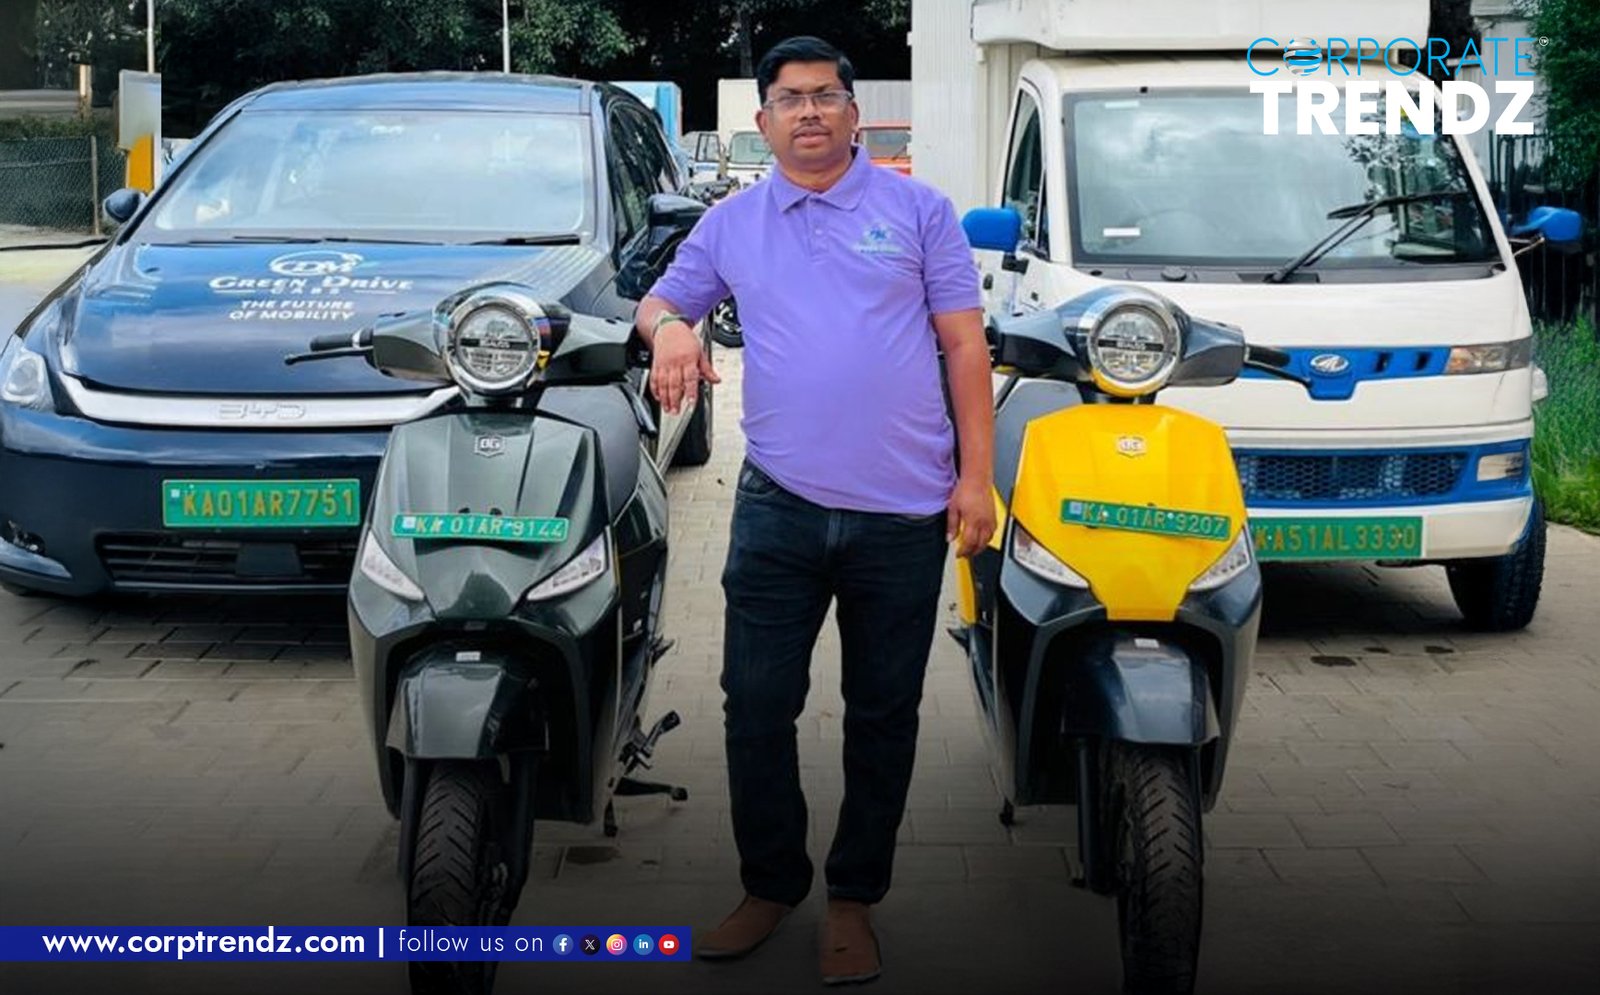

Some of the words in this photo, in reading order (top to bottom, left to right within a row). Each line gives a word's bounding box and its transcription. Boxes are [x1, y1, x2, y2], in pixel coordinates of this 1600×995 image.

[241, 300, 275, 309] THE
[279, 300, 354, 309] FUTURE
[229, 310, 254, 320] OF
[259, 310, 356, 321] MOBILITY
[183, 489, 355, 517] KA01AR7751
